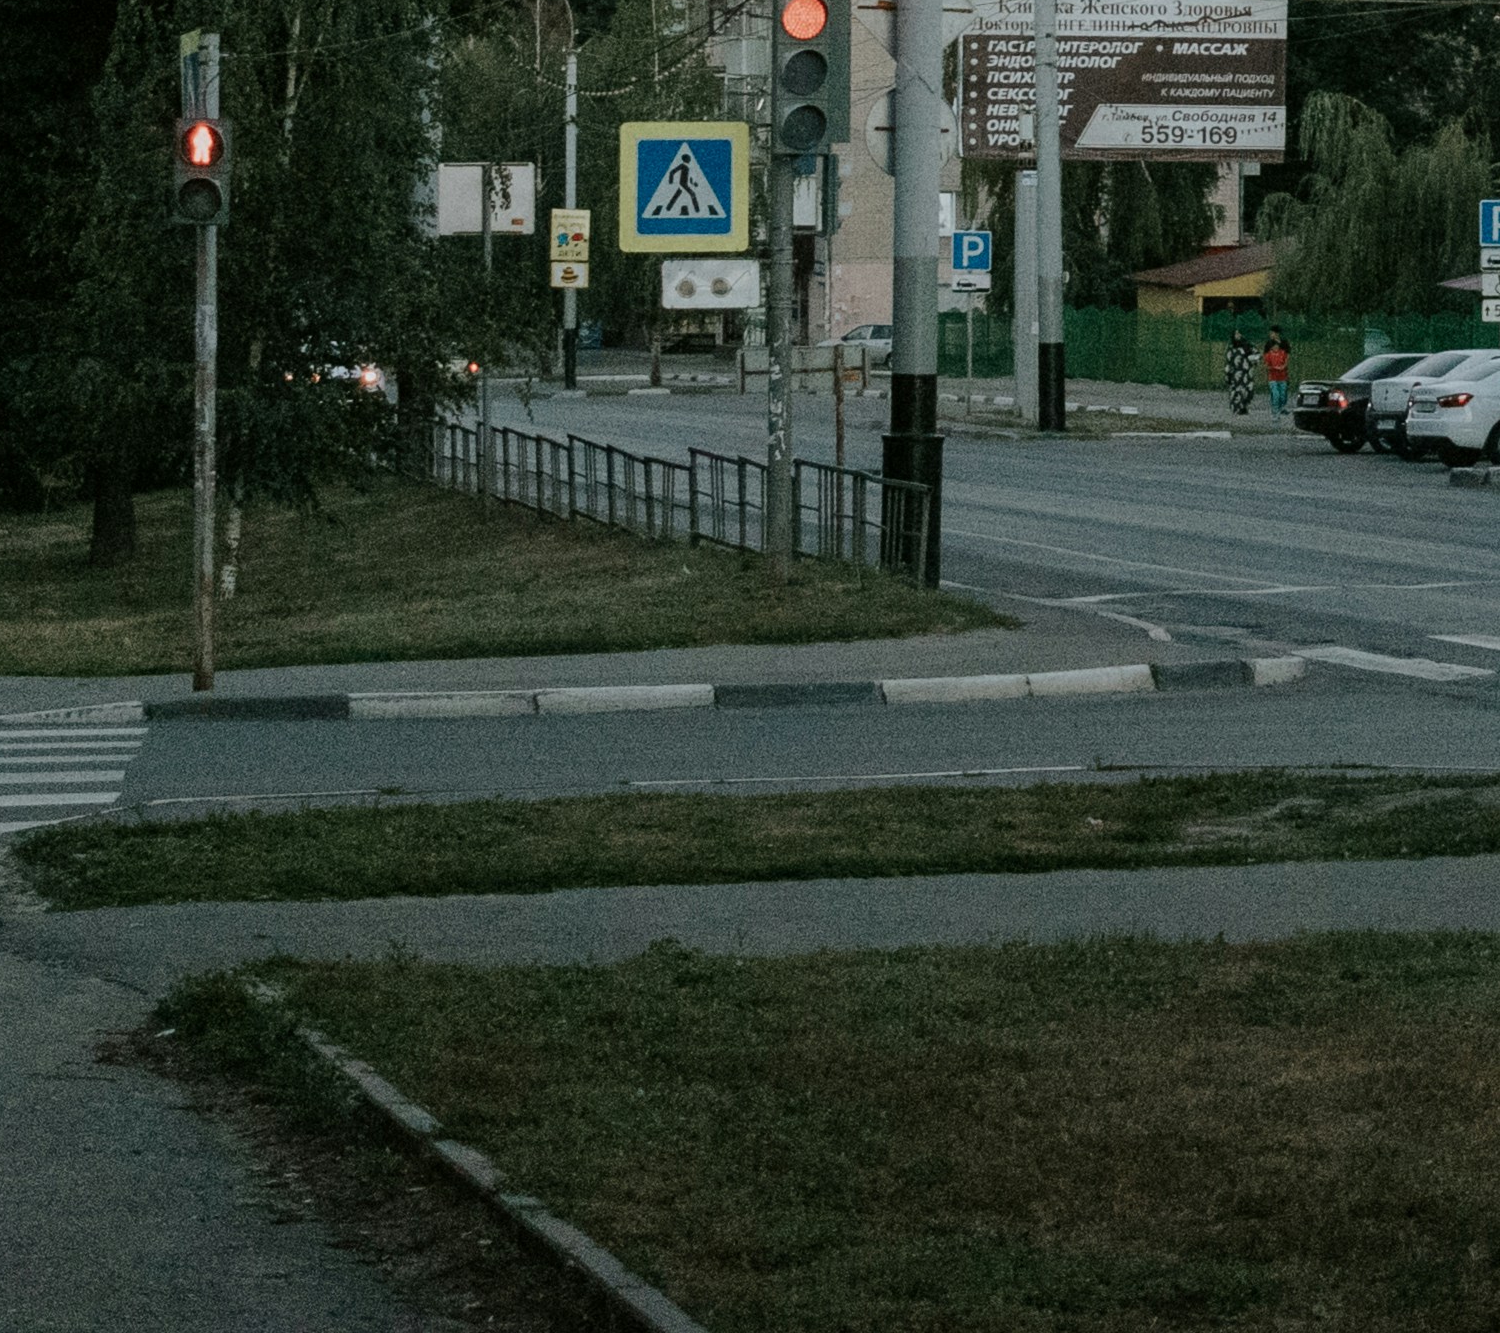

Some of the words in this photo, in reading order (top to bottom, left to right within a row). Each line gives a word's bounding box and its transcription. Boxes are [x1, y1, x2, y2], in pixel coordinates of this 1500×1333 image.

[1173, 0, 1252, 18] Здоровья
[1056, 19, 1136, 32] НГЕЛИНЫ
[987, 40, 1143, 54] ГАСТРНТЕРОЛОГ
[1172, 43, 1249, 56] МАССАЖ
[986, 55, 1122, 69] ЭНДОИНОЛОГ
[986, 71, 1075, 84] ПСИХТР
[1141, 72, 1233, 84] ИНДИВИДУАЛЬНЫЙ
[1234, 73, 1275, 85] ПОДХОД
[1160, 88, 1168, 97] К
[1169, 88, 1221, 98] КАЖДОМУ
[1221, 88, 1275, 99] ПАЦИЕНТУ
[1171, 110, 1256, 124] Свободная
[1261, 111, 1277, 123] 14
[1141, 125, 1238, 146] 559-169
[963, 236, 984, 267] P
